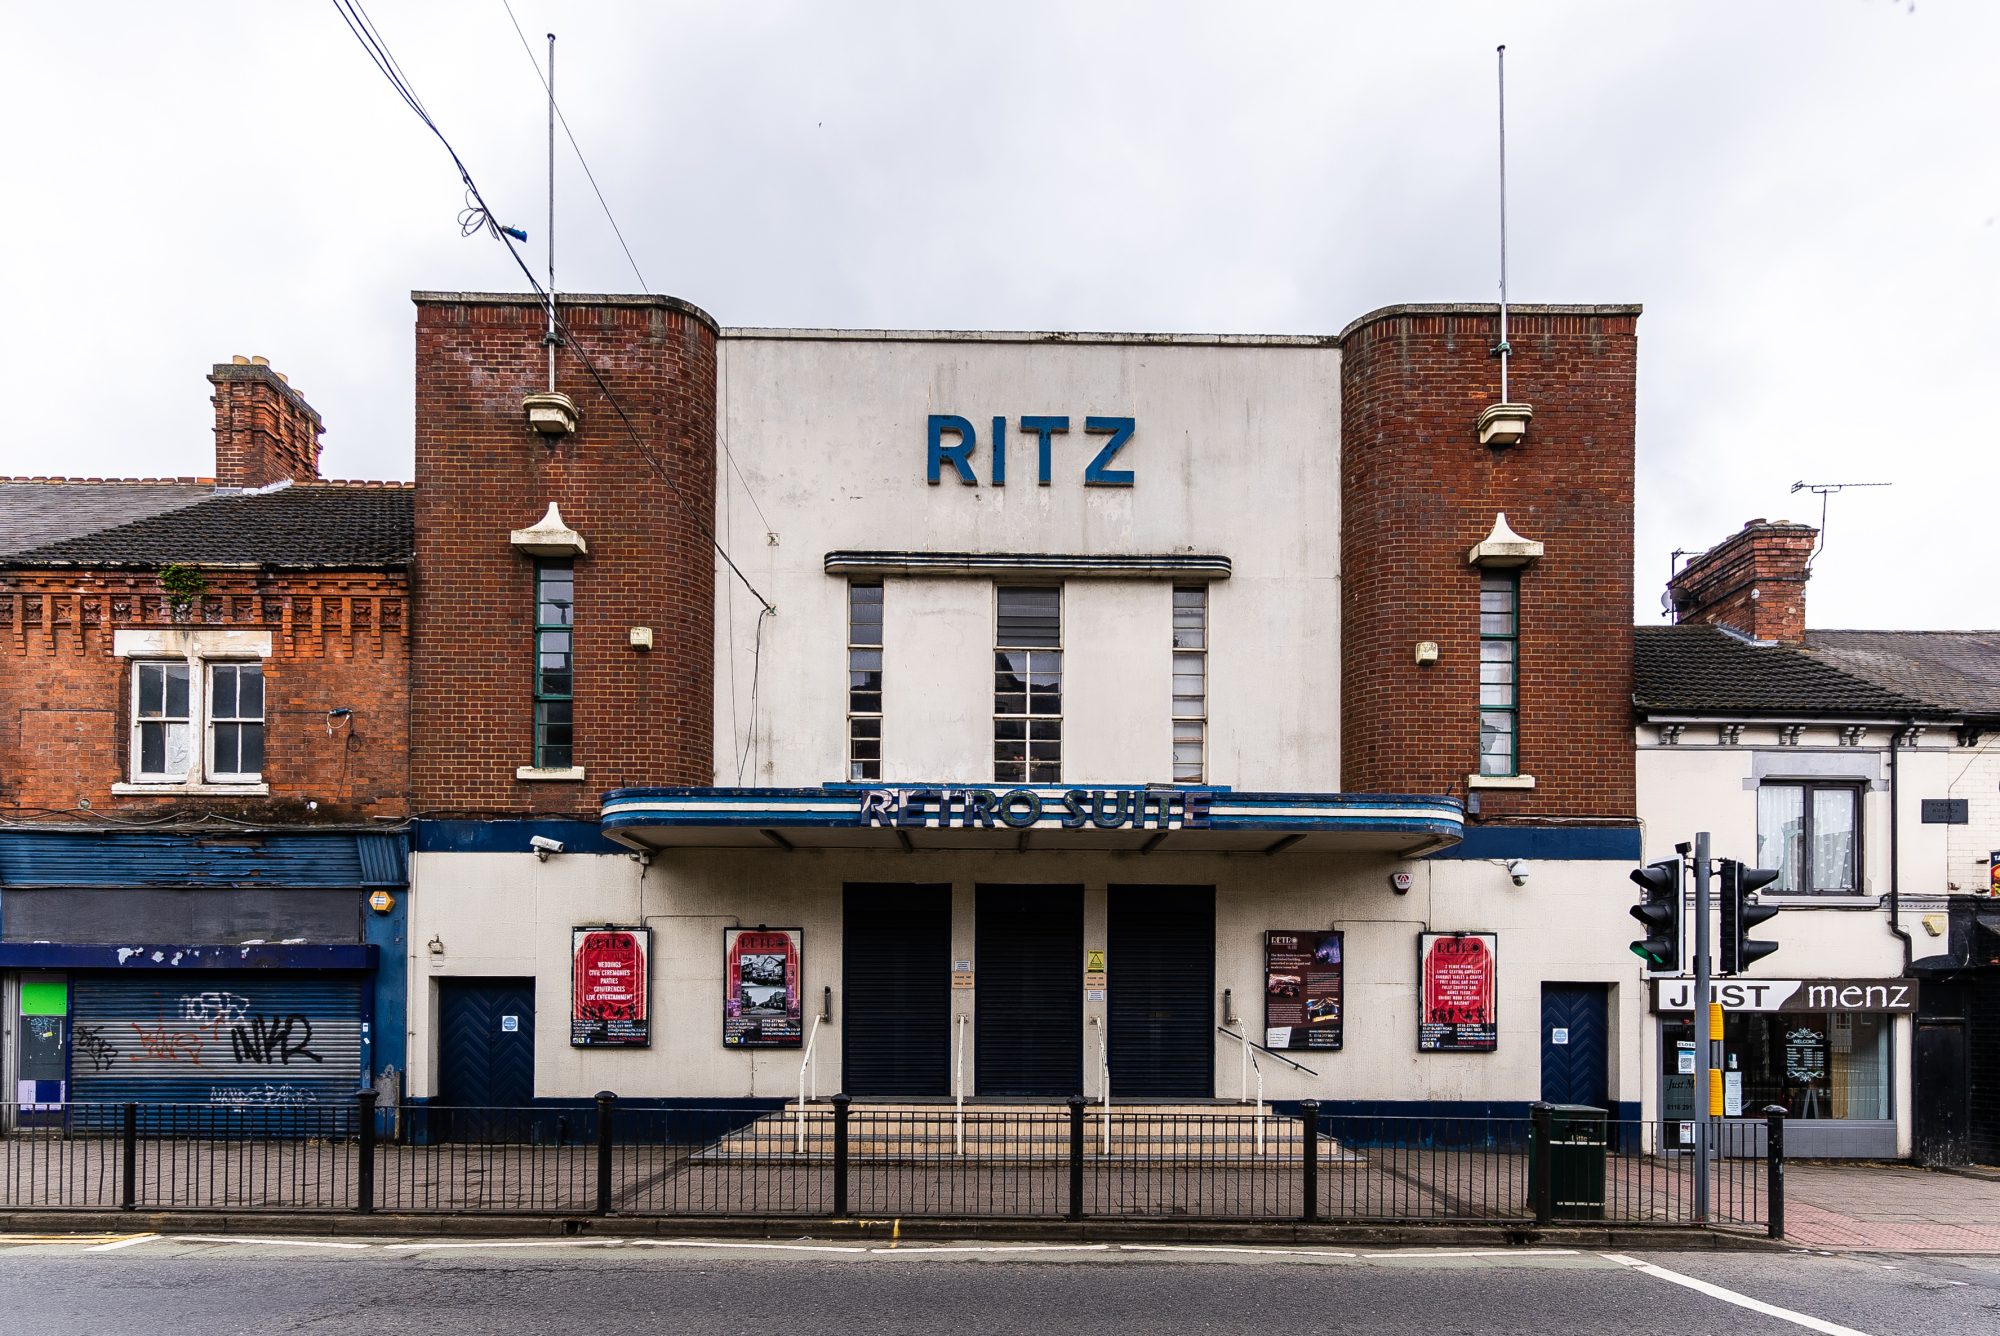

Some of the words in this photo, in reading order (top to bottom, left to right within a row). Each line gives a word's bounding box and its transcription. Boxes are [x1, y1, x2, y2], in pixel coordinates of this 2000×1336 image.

[928, 414, 1135, 487] RITZ
[860, 788, 1043, 829] RETRO
[1062, 788, 1213, 829] SUITE
[1271, 936, 1298, 944] RETRO
[1437, 943, 1480, 953] RETRO
[1808, 984, 1910, 1008] menz
